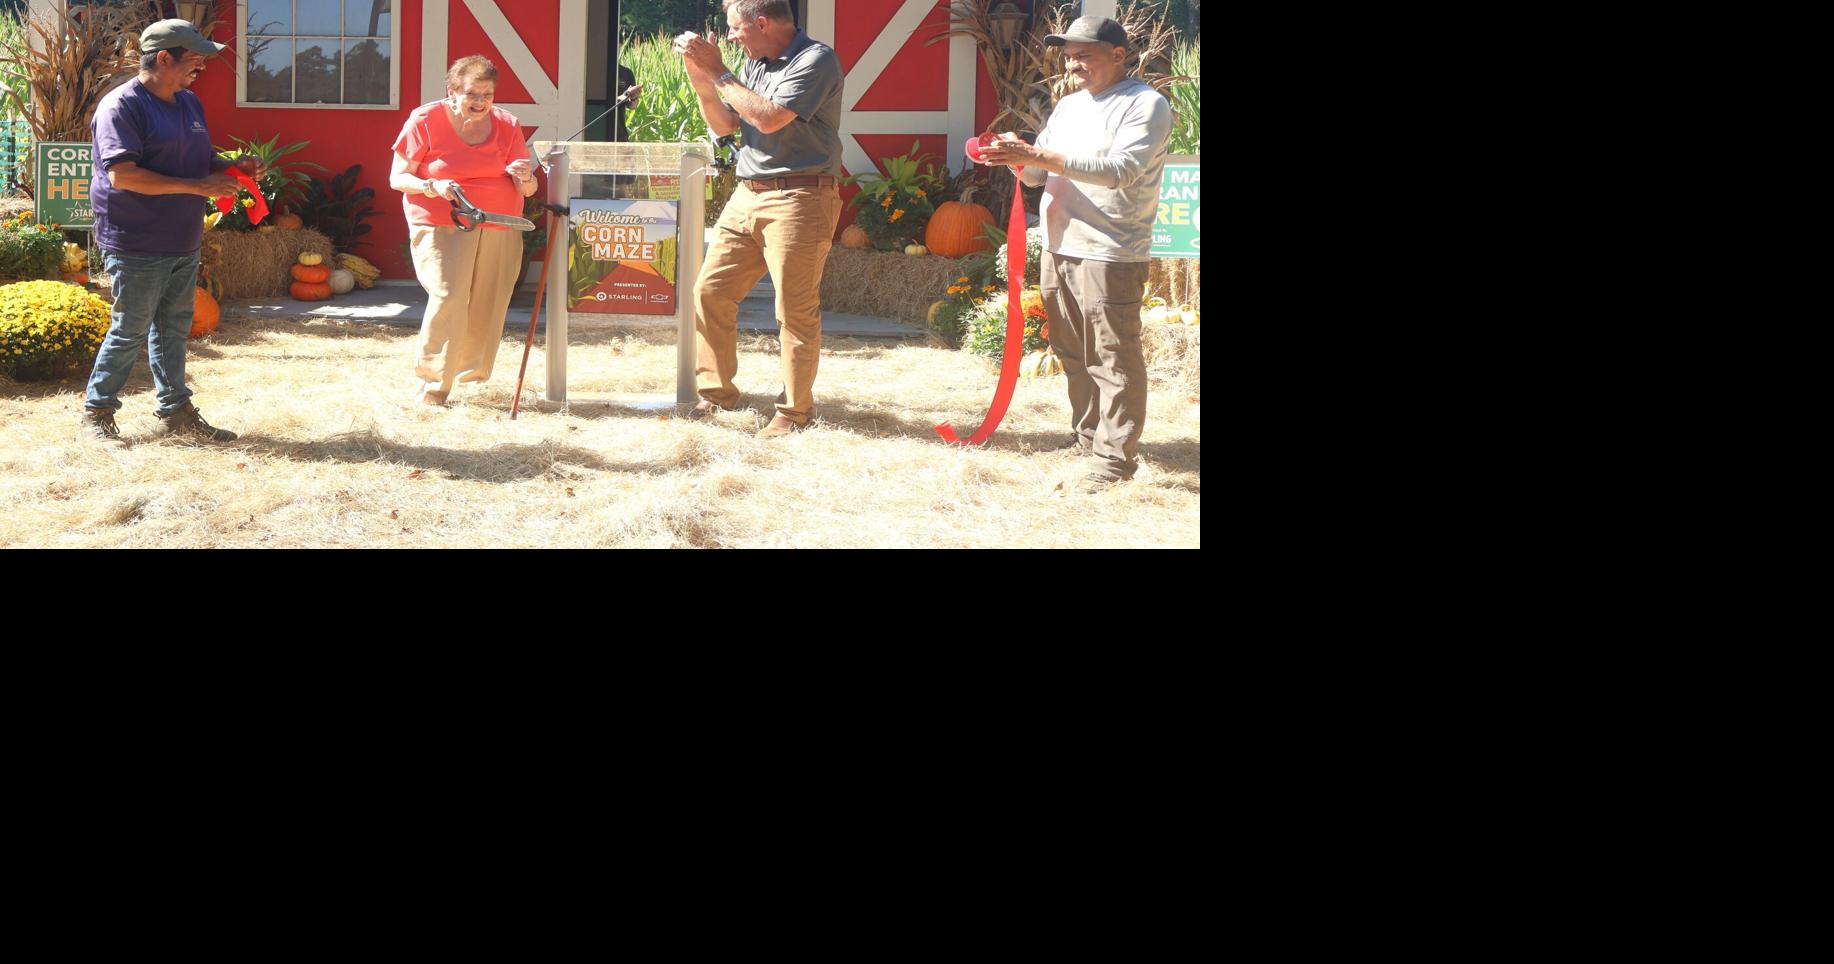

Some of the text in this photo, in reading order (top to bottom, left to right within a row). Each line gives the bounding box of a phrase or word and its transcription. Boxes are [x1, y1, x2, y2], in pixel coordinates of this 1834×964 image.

[47, 148, 95, 161] COR
[74, 208, 96, 218] STAR
[579, 209, 641, 224] Welcome
[584, 226, 642, 243] CORN
[594, 243, 654, 260] MAZE
